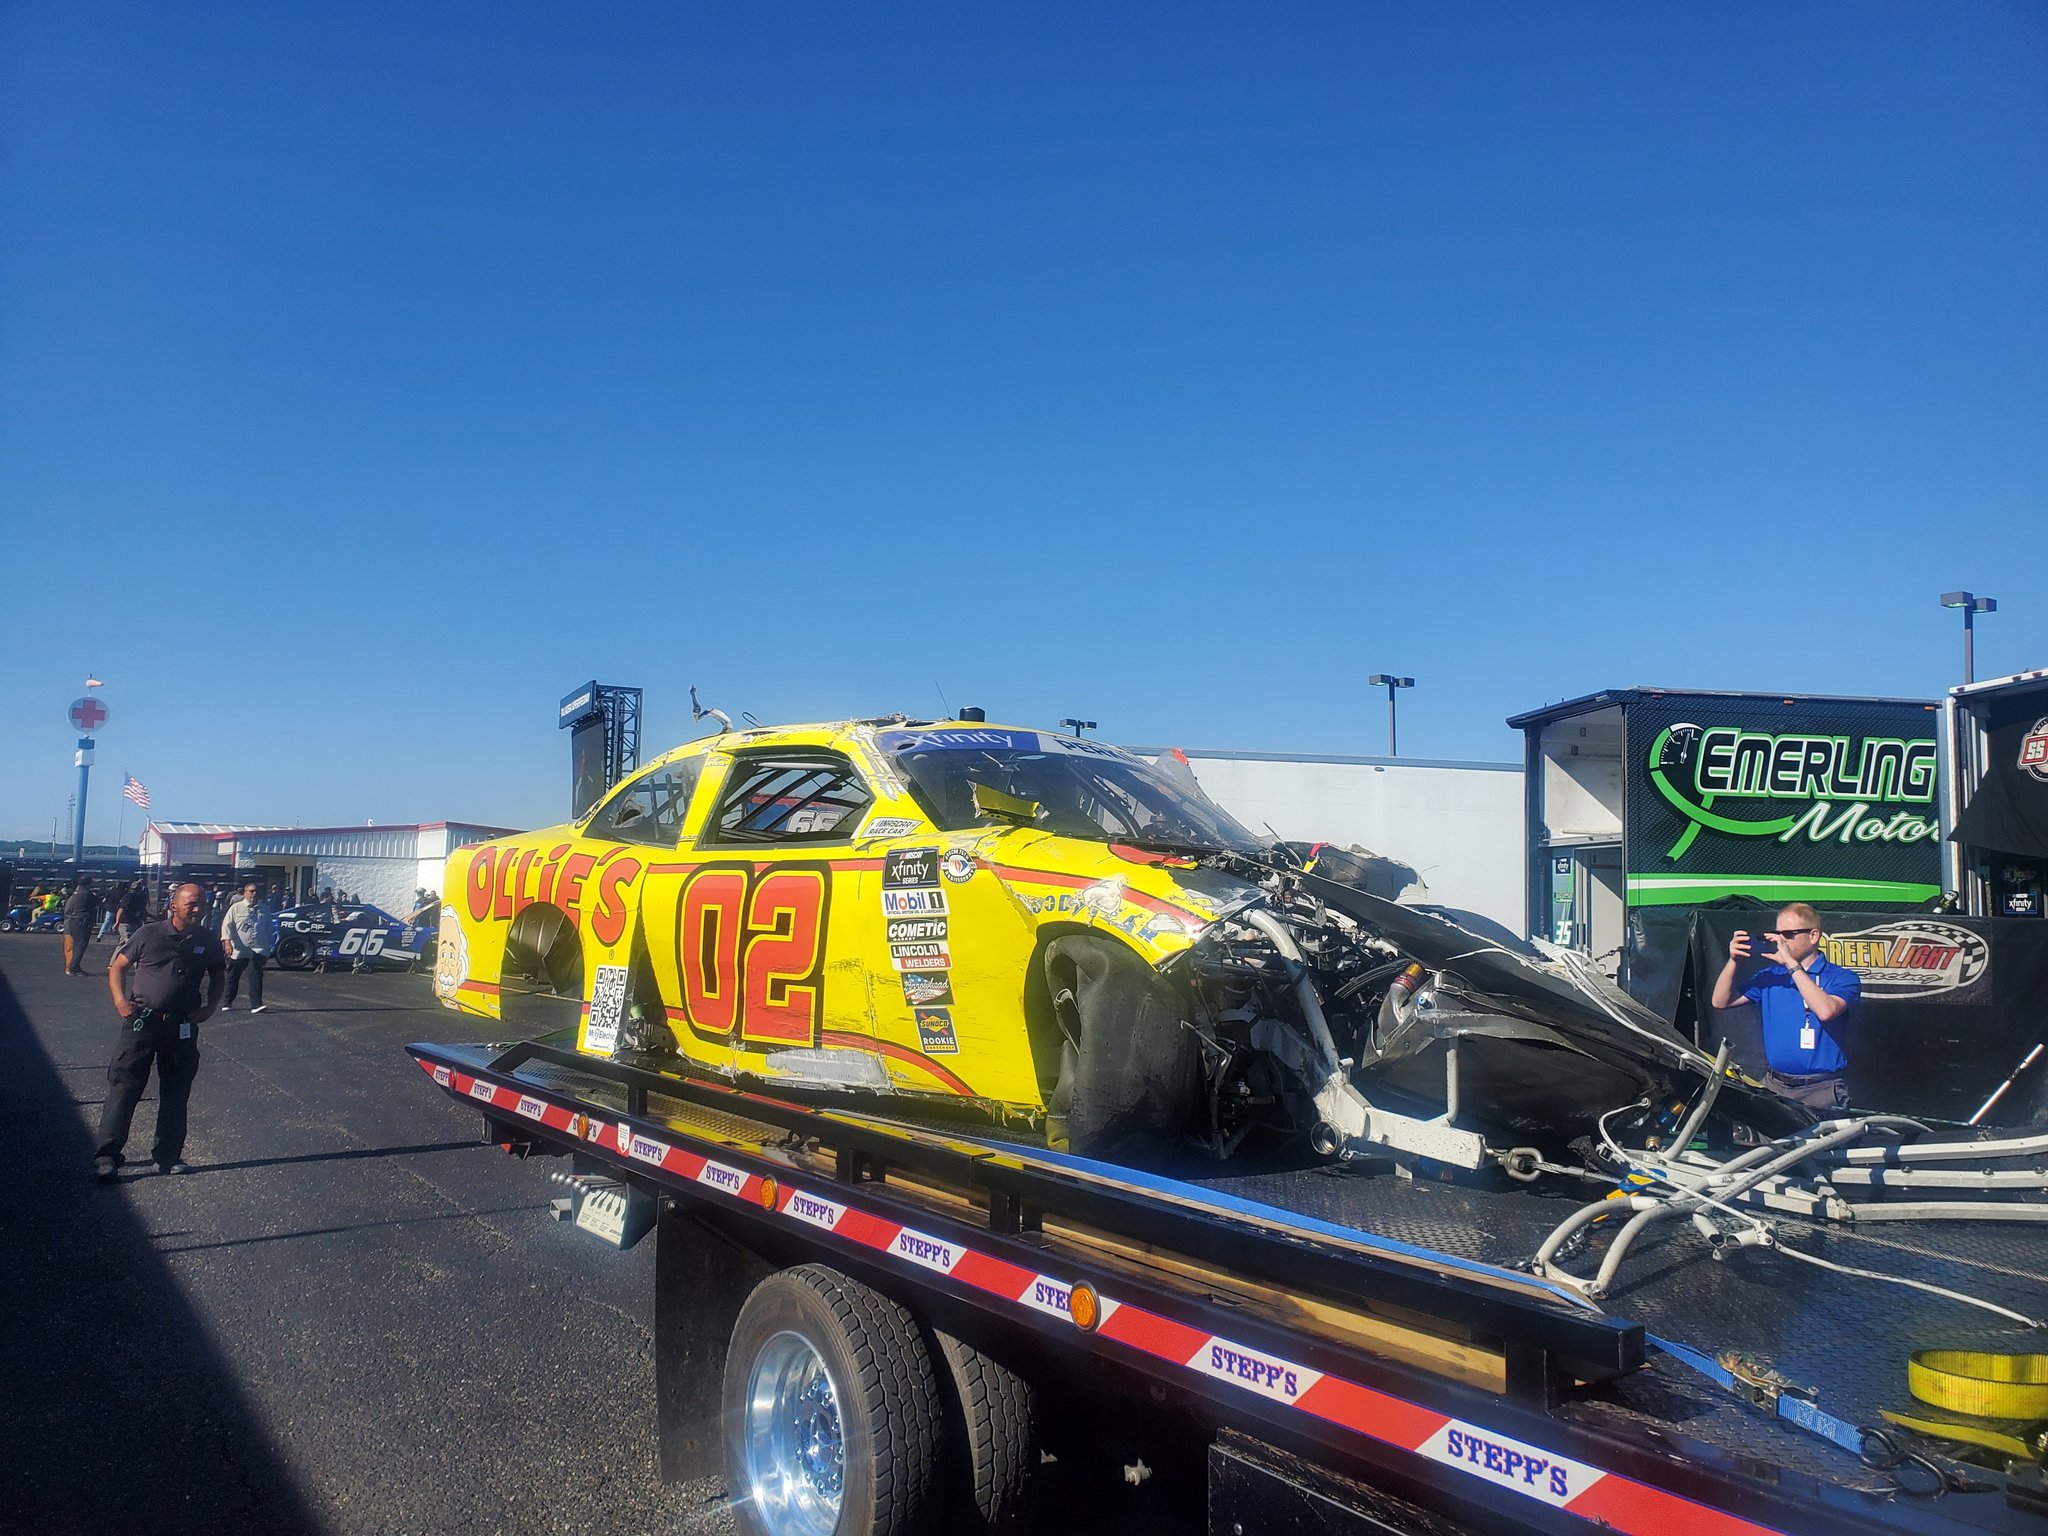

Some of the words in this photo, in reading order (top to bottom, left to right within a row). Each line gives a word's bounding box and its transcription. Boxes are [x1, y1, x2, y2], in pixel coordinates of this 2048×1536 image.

[898, 731, 1013, 748] xfinity
[1698, 728, 1937, 802] EMERLING
[877, 819, 912, 828] NASCAR
[901, 851, 924, 860] NASCAR
[891, 860, 929, 881] xfinity
[902, 877, 919, 885] SERIES
[884, 892, 926, 911] Mobil
[2008, 898, 2032, 910] xfinity
[888, 922, 947, 938] COMETIC
[1554, 921, 1572, 945] 35
[339, 928, 388, 956] 66
[893, 944, 939, 957] LINCOLN
[678, 867, 827, 1047] 02
[905, 958, 946, 968] WELDERS
[921, 1020, 948, 1028] SUNOCO
[923, 1037, 954, 1045] ROOKIE
[436, 1070, 449, 1082] STEPP
[474, 1083, 492, 1099] STEPP'S
[520, 1100, 541, 1117] STEPP'S
[633, 1140, 662, 1162] STEPP'S
[706, 1165, 740, 1190] STEPP'S
[793, 1196, 834, 1225] STEPP'S
[900, 1233, 950, 1268] STEPP'S
[1211, 1344, 1298, 1397] STEPP'S
[1447, 1428, 1568, 1498] STEPP'S
